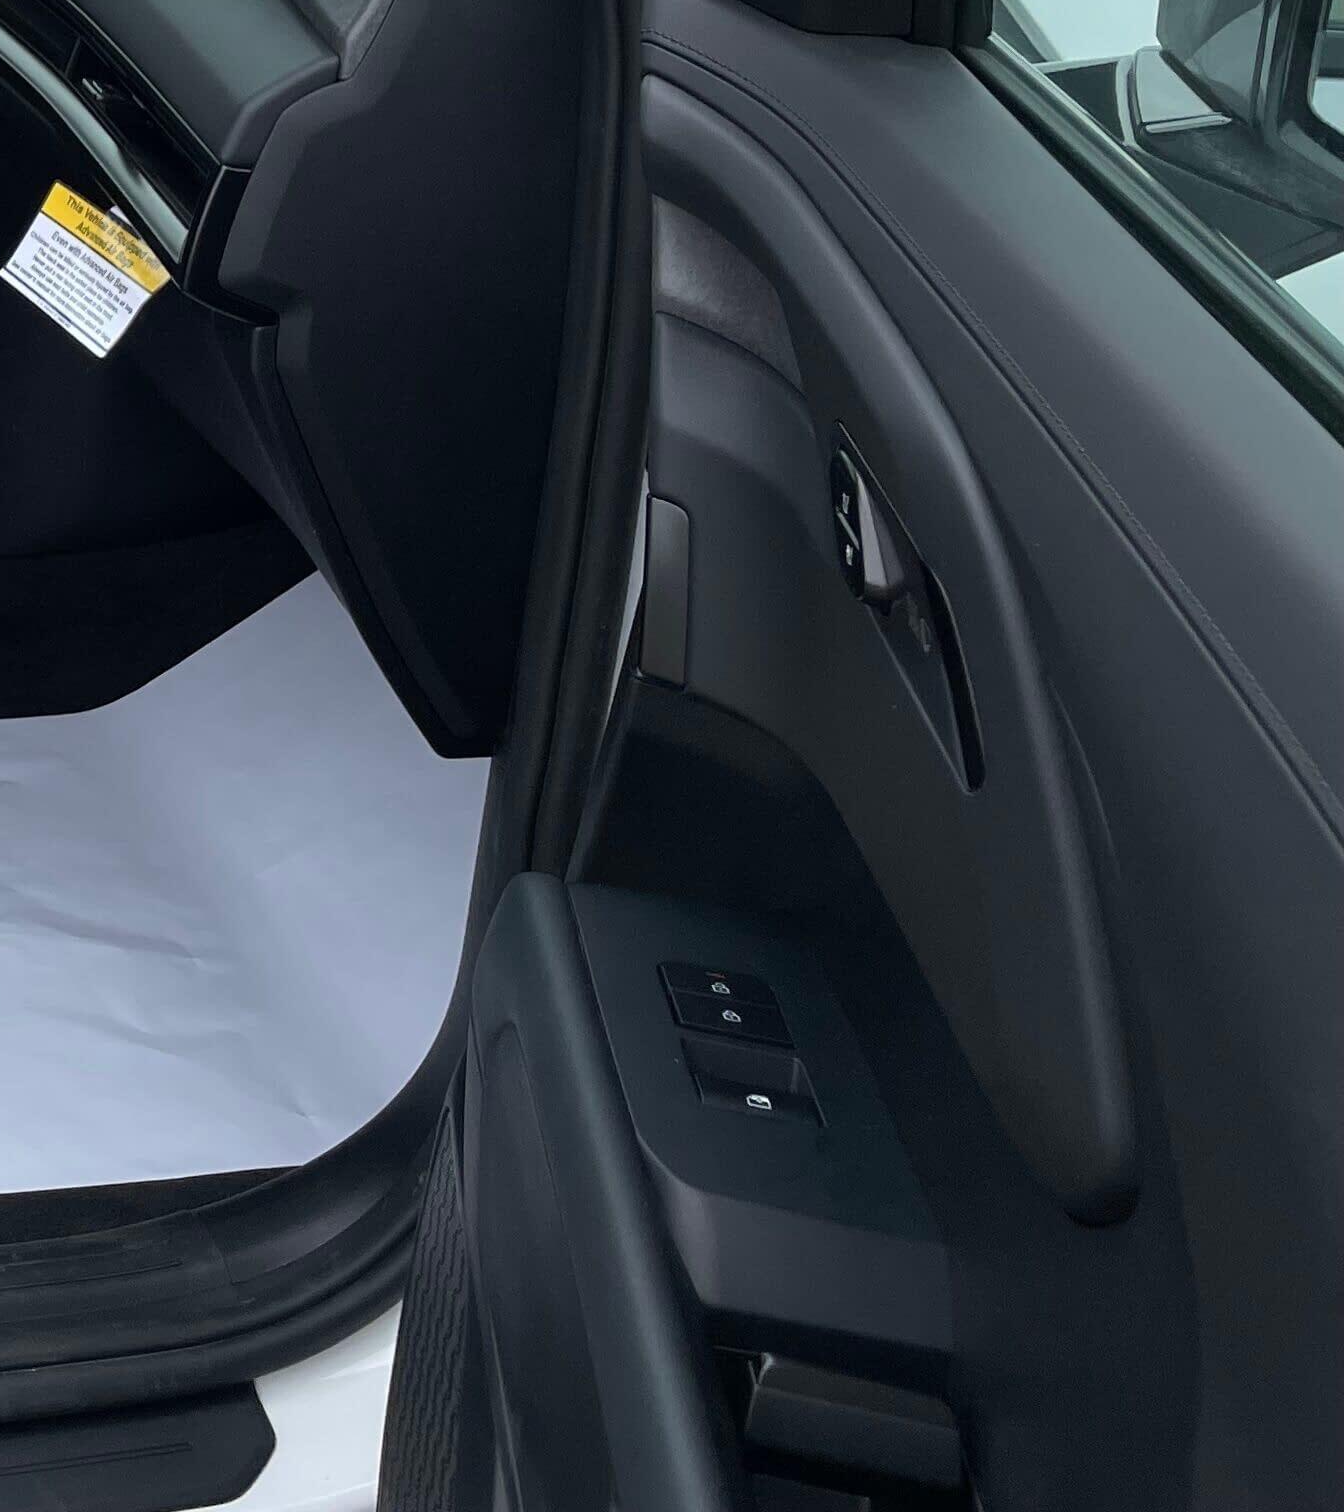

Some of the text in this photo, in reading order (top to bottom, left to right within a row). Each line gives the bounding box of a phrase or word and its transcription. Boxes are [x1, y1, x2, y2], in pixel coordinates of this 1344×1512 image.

[66, 196, 84, 212] This
[51, 231, 69, 247] Even
[68, 244, 81, 256] with
[80, 253, 107, 276] Advanced
[105, 272, 114, 282] Air
[111, 278, 129, 295] Bags
